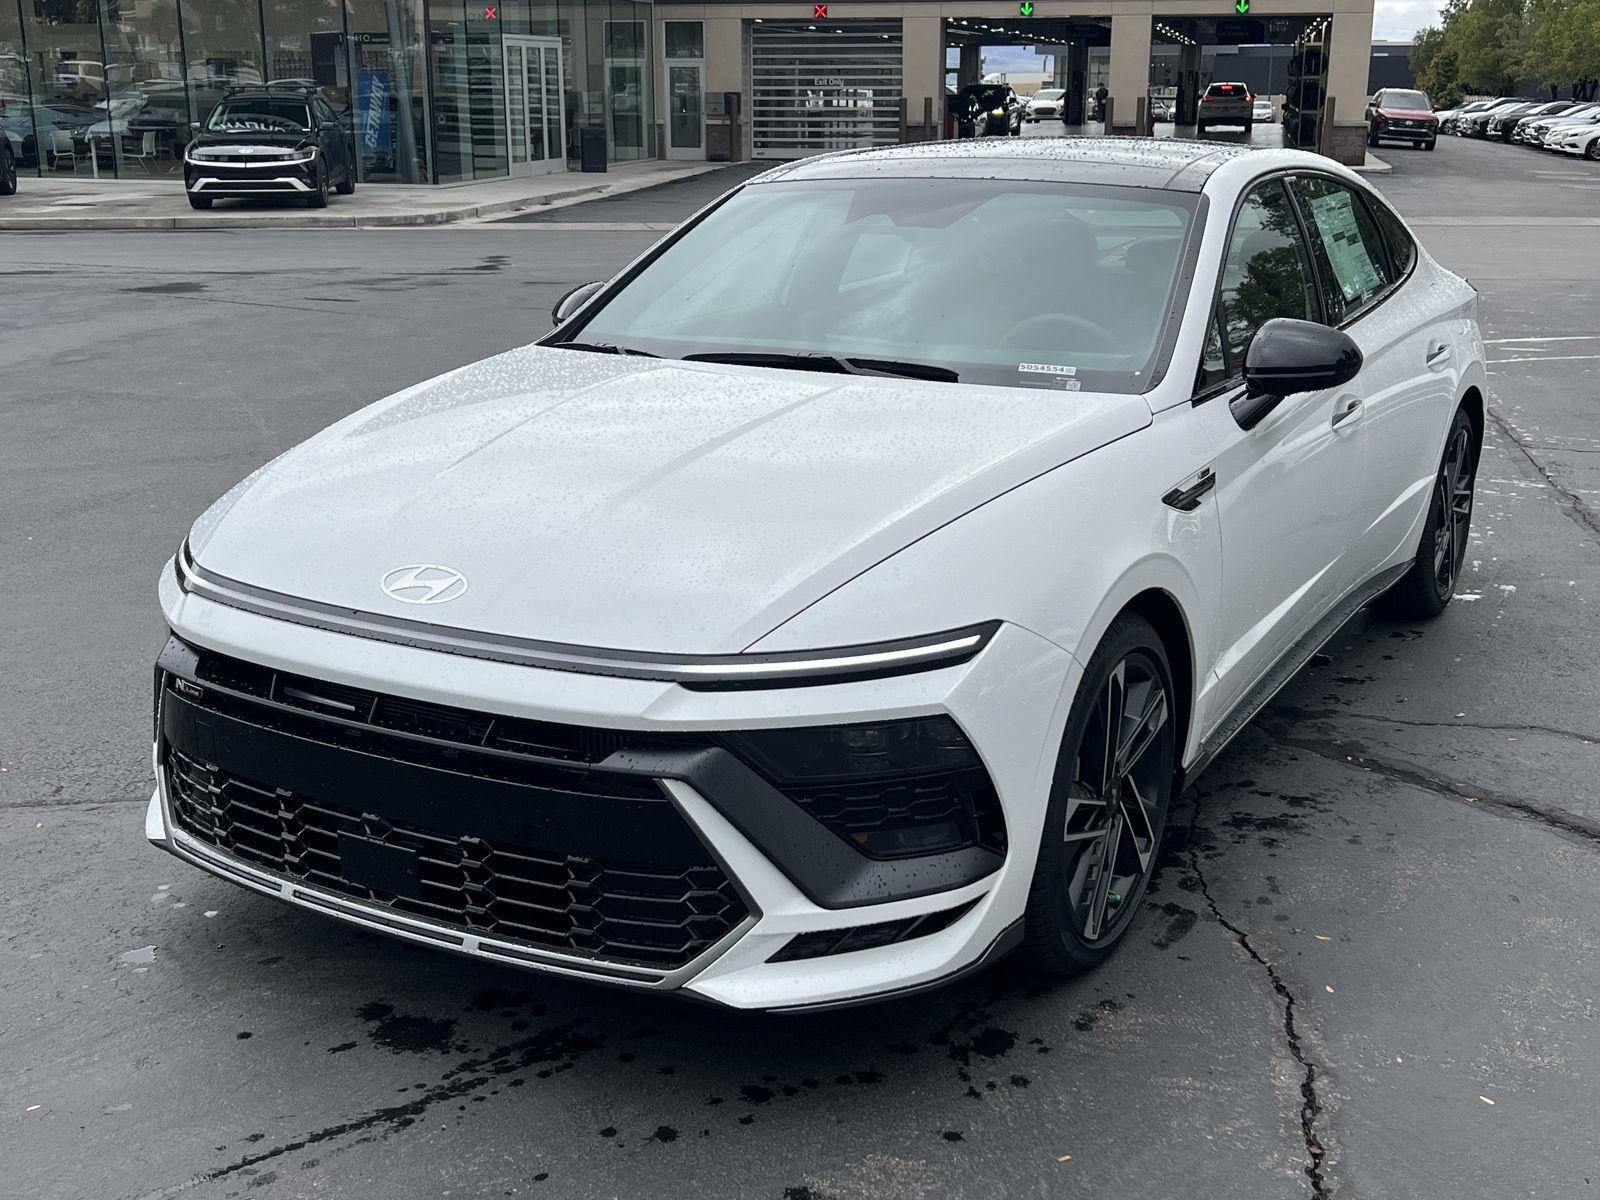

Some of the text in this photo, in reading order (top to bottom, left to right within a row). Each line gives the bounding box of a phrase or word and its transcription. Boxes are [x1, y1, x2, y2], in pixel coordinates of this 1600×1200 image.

[814, 78, 845, 87] Exit Only
[365, 74, 385, 153] GETAWAY
[175, 678, 199, 696] N Line
